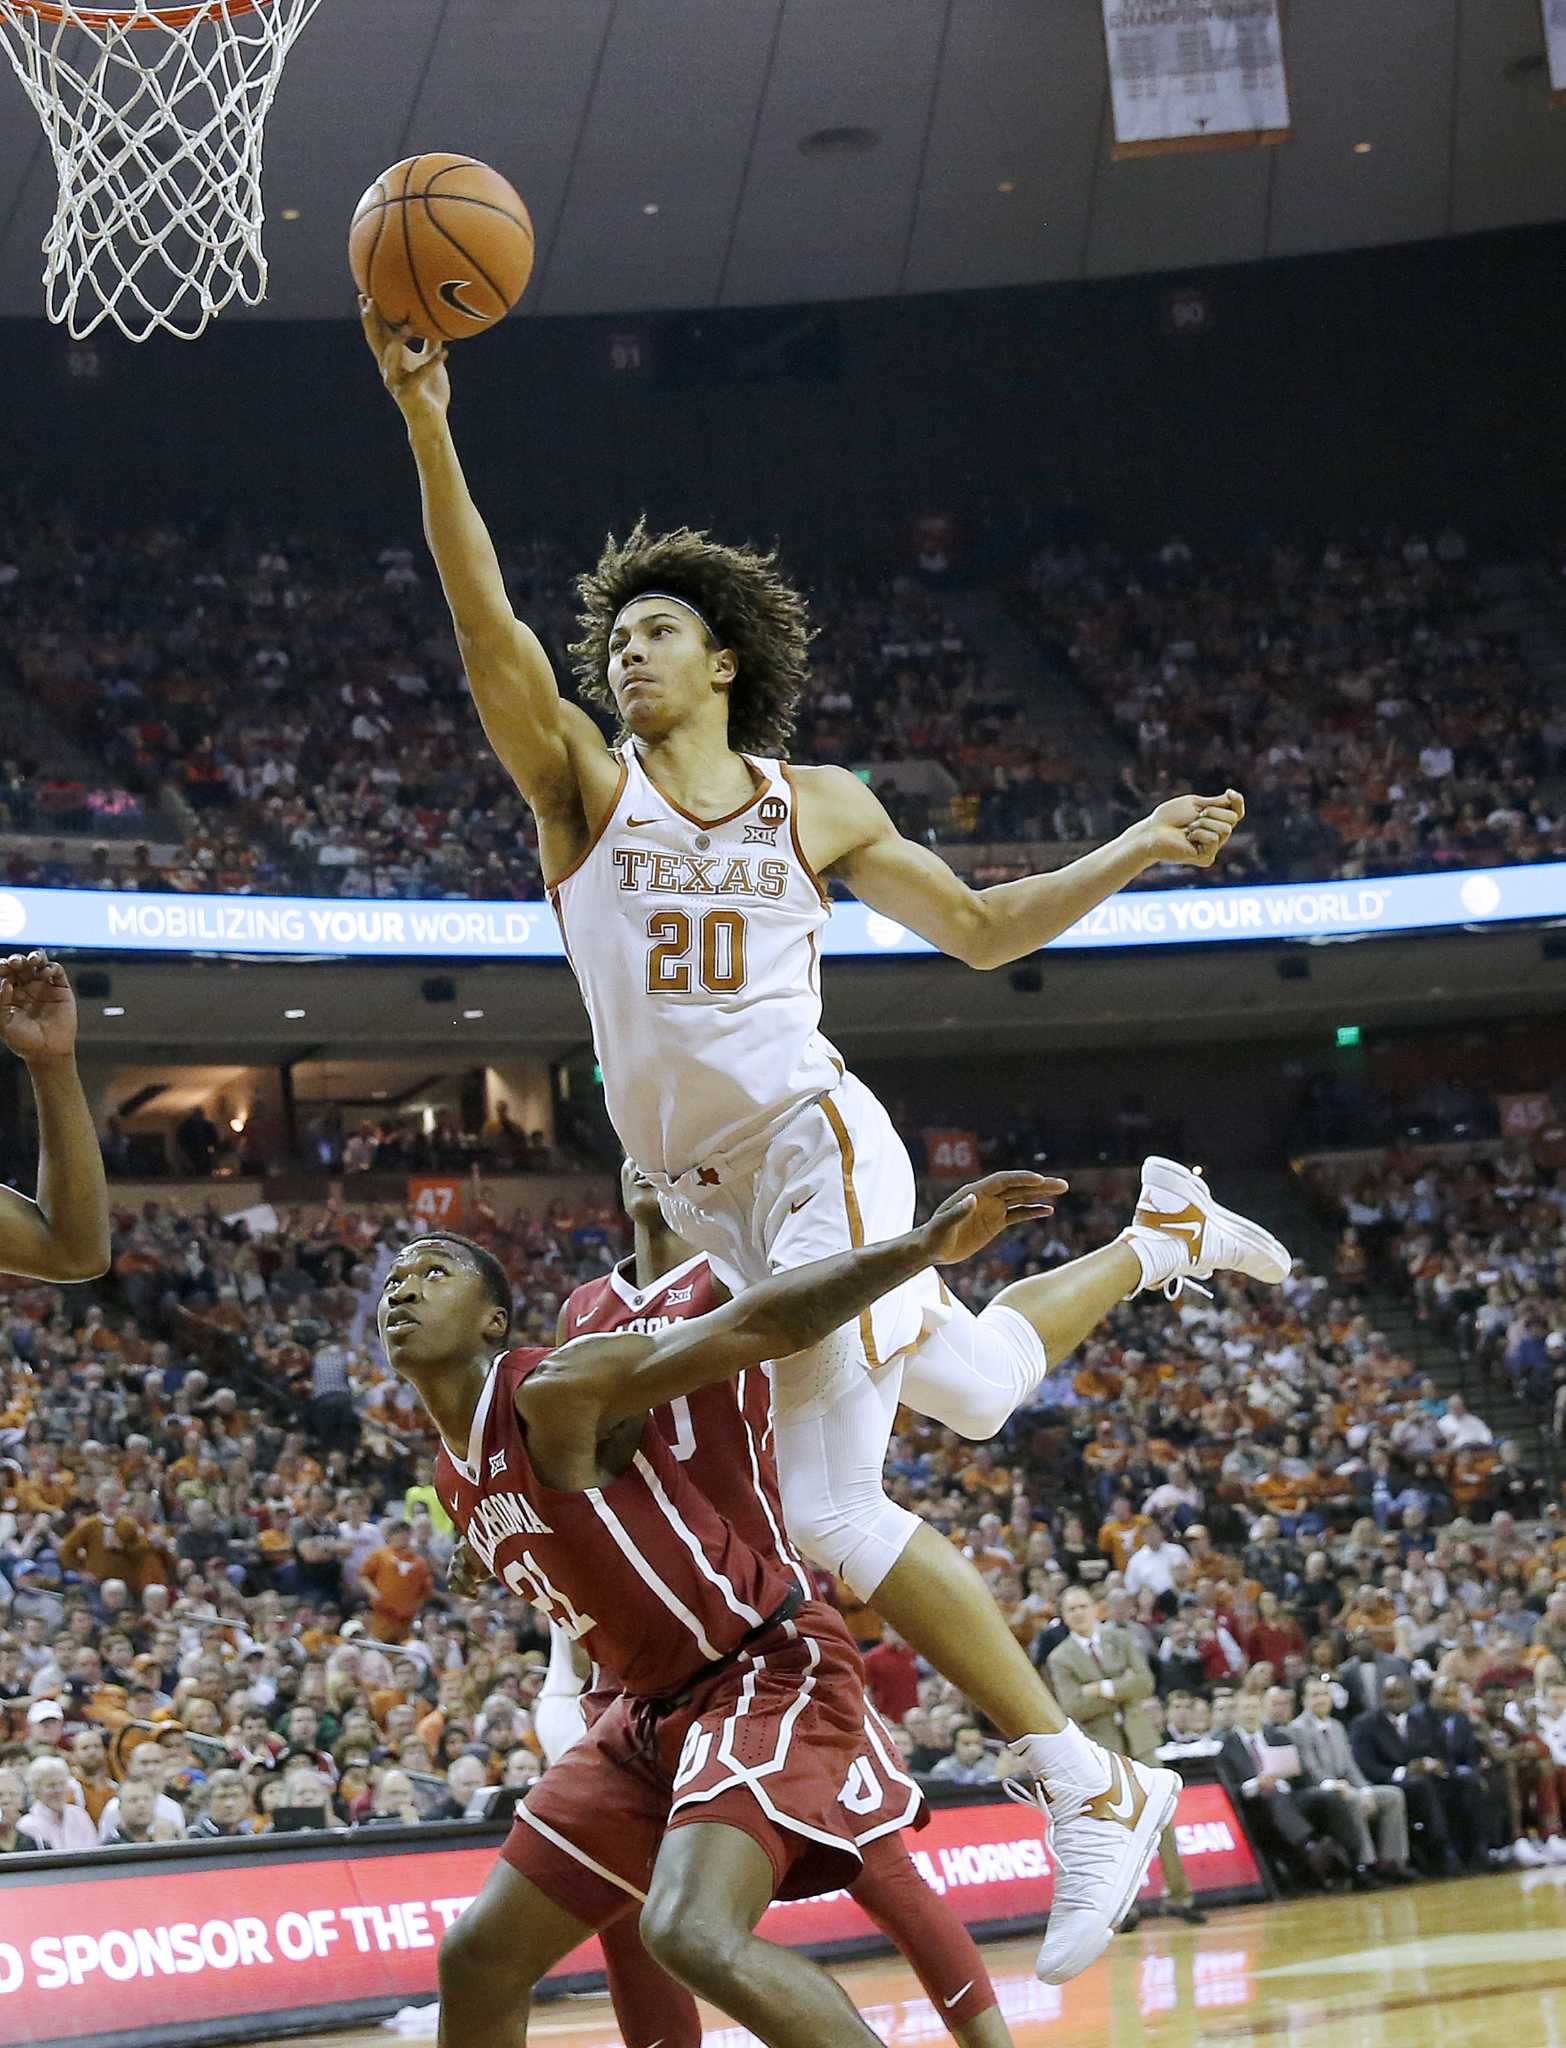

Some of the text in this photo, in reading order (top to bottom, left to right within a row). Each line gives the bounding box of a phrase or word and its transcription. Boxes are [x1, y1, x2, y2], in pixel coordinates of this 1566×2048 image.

[613, 848, 788, 900] TEXAS
[107, 904, 306, 941] MOBILIZING
[309, 909, 405, 943] YOUR
[1169, 896, 1262, 930] YOUR
[646, 907, 748, 994] 20
[934, 1141, 972, 1168] 46
[415, 1187, 453, 1215] 47
[938, 1838, 1051, 1887] HORNS!
[30, 1916, 273, 1990] SPONSOR
[275, 1908, 341, 1962] OF
[340, 1900, 436, 1953] THE
